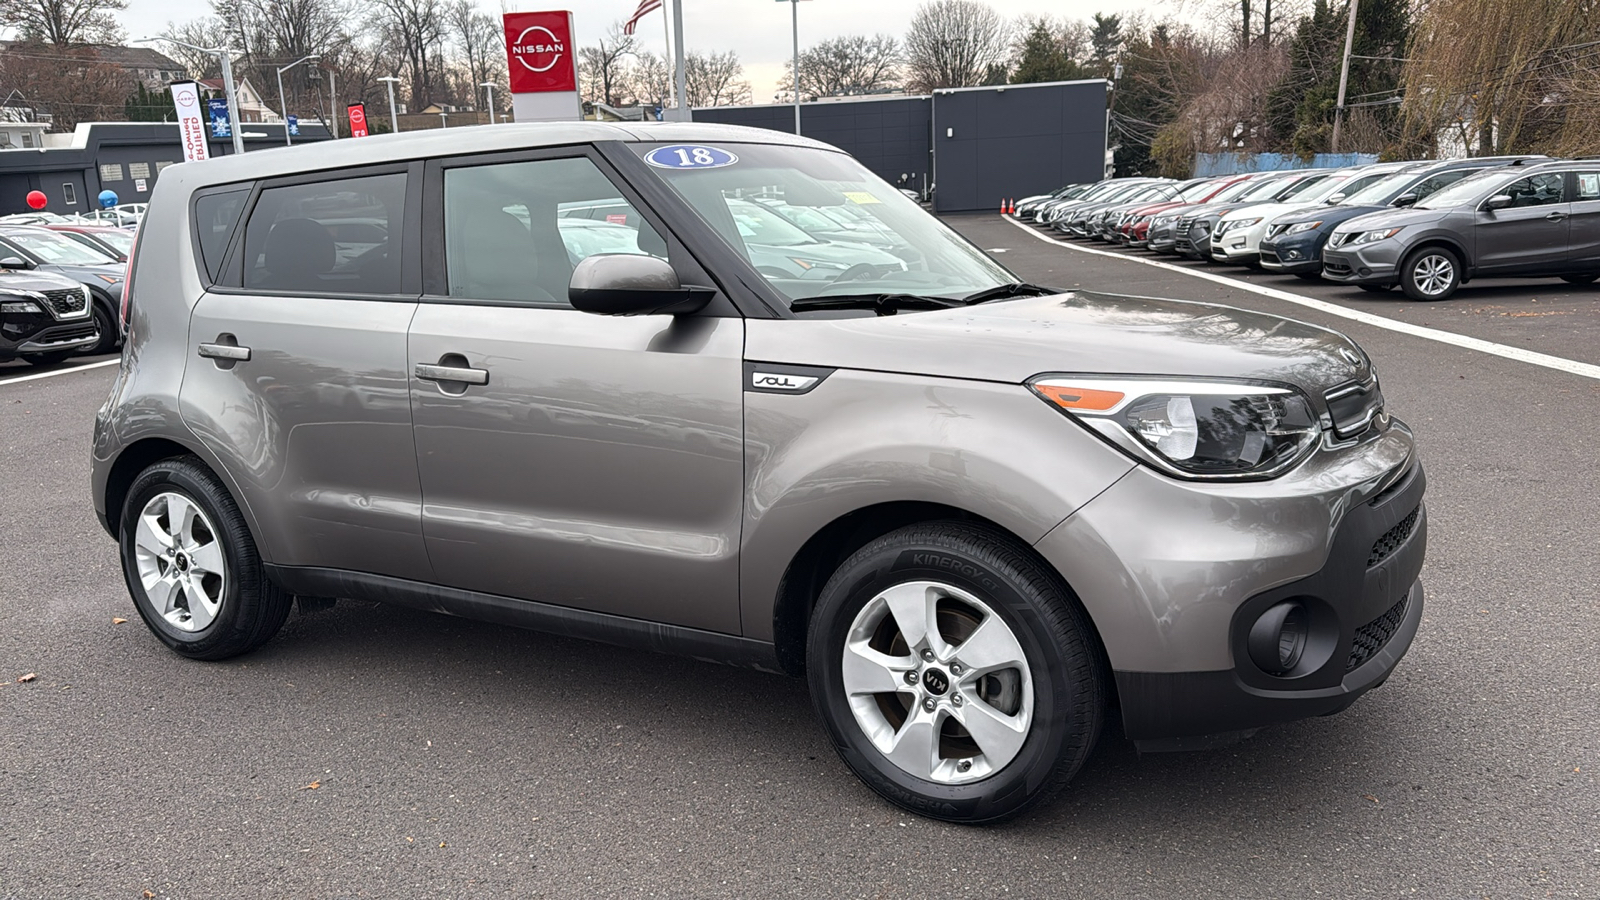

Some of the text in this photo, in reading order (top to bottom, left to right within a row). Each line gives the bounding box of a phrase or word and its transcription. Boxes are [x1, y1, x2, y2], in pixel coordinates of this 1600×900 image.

[512, 43, 564, 54] NISSAN
[673, 147, 715, 166] 18
[913, 553, 1000, 591] KINERGY GT
[926, 672, 946, 692] KIA
